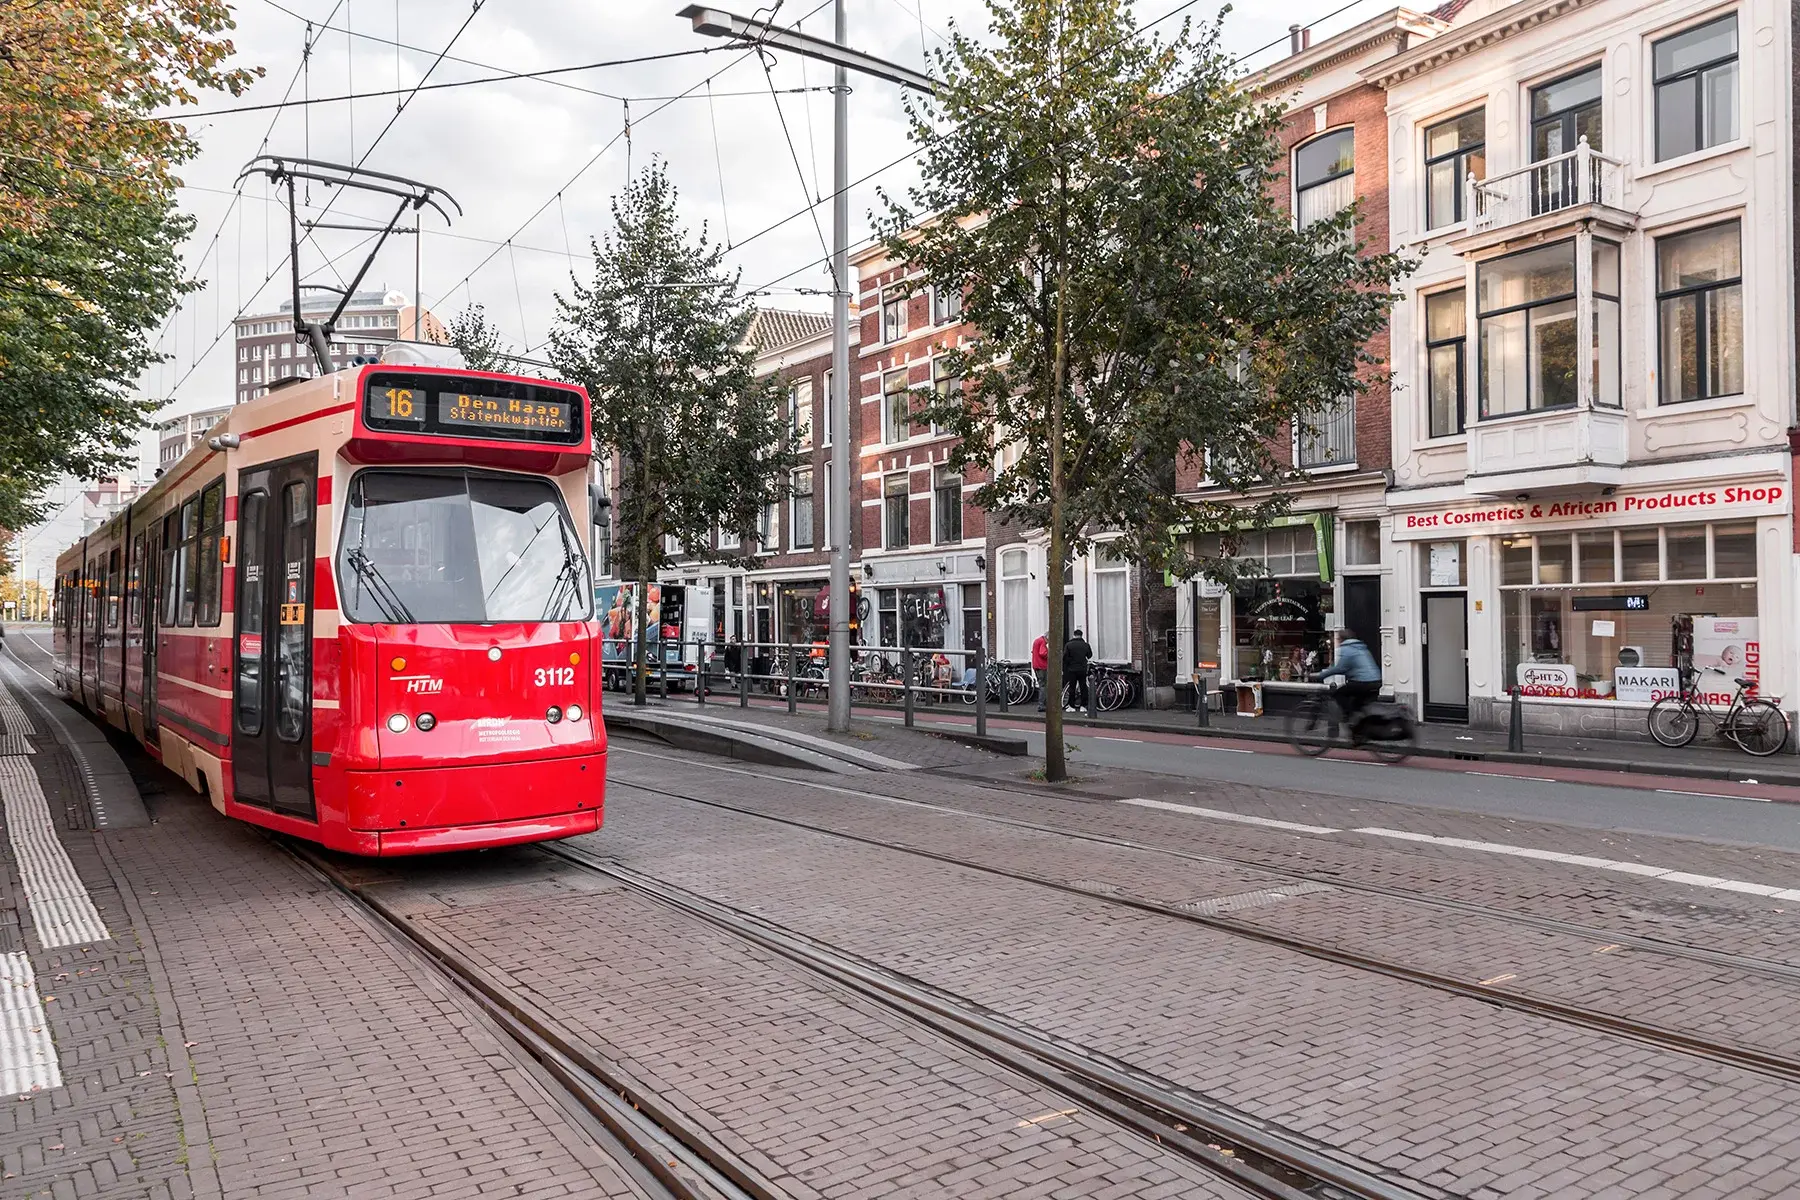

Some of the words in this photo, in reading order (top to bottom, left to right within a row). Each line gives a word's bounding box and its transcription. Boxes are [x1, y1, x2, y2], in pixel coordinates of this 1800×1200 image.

[385, 388, 413, 417] 16
[458, 395, 498, 410] Den
[509, 400, 560, 416] Haag
[450, 407, 565, 428] Statenkwartier
[1407, 514, 1438, 528] Best
[1443, 507, 1525, 525] Cosmetics
[1530, 504, 1542, 519] &
[1548, 500, 1617, 516] African
[1624, 491, 1716, 511] Products
[1724, 487, 1783, 504] Shop
[406, 678, 444, 693] HTM
[534, 667, 575, 687] 3112
[1554, 674, 1563, 682] 26
[1618, 676, 1674, 687] MAKARI
